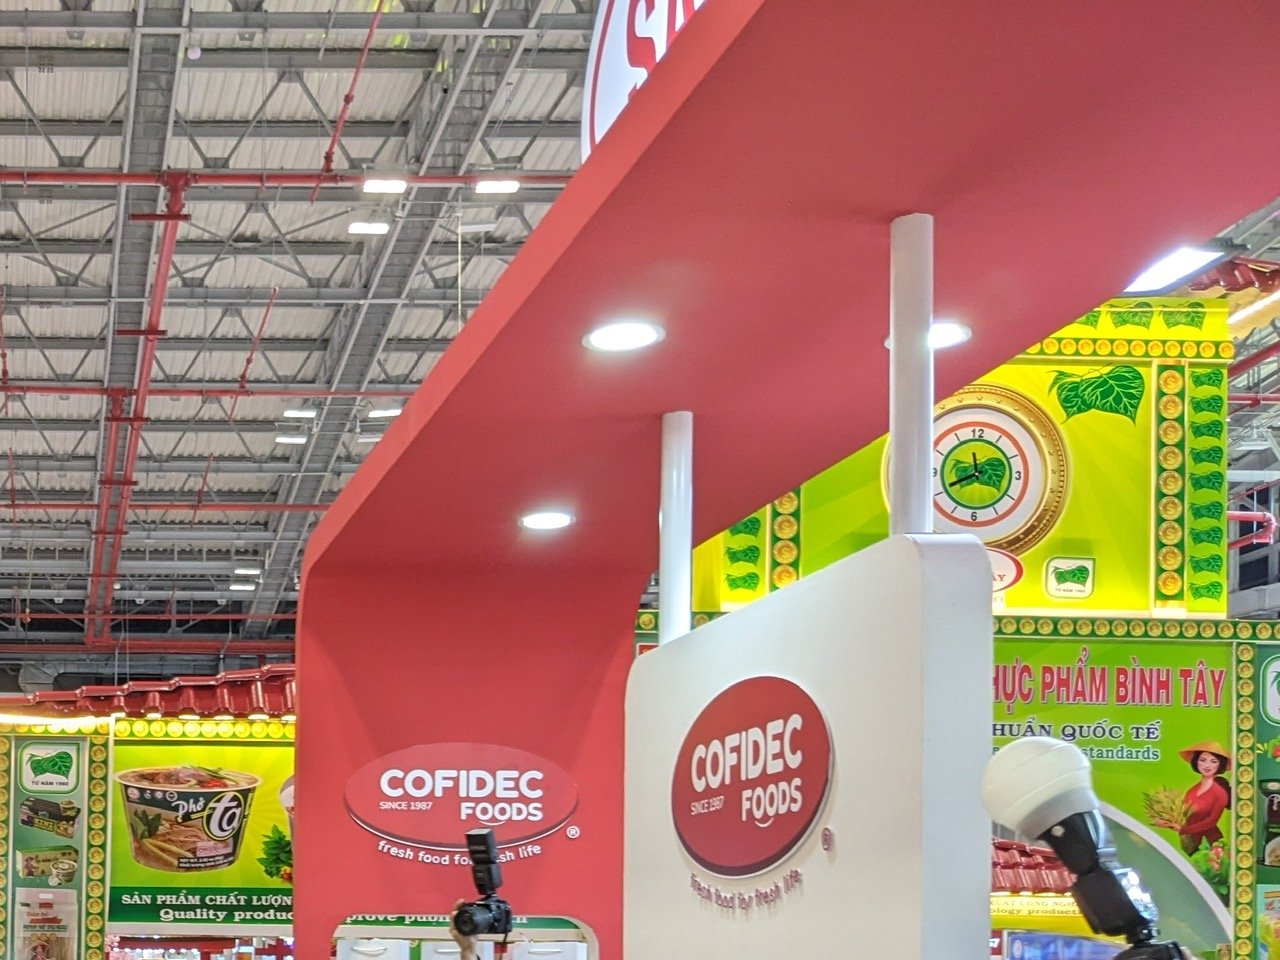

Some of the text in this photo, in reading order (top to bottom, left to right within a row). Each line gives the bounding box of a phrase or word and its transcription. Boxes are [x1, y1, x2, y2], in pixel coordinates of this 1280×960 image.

[971, 429, 984, 438] 12
[1014, 471, 1022, 480] 3
[970, 512, 978, 521] 6
[1040, 646, 1107, 705] PHẨM
[1115, 657, 1172, 706] BÌNH
[1179, 660, 1226, 708] TÂY
[1062, 720, 1122, 741] QUỐC
[1130, 721, 1160, 740] TẾ
[691, 713, 803, 793] COFIDEC
[1084, 746, 1160, 760] standards
[380, 769, 544, 798] COFIDEC
[379, 801, 433, 811] SINCE 1987
[690, 797, 710, 816] SINCE
[741, 777, 802, 822] FOODS
[172, 797, 206, 822] Phở
[210, 792, 241, 838] ta
[460, 802, 543, 822] FOODS
[378, 841, 414, 860] fresh
[418, 851, 449, 865] food
[518, 844, 542, 859] life
[122, 892, 152, 904] SẢN
[156, 890, 200, 905] PHẨM
[206, 892, 248, 906] CHẤT
[160, 908, 228, 921] Quality
